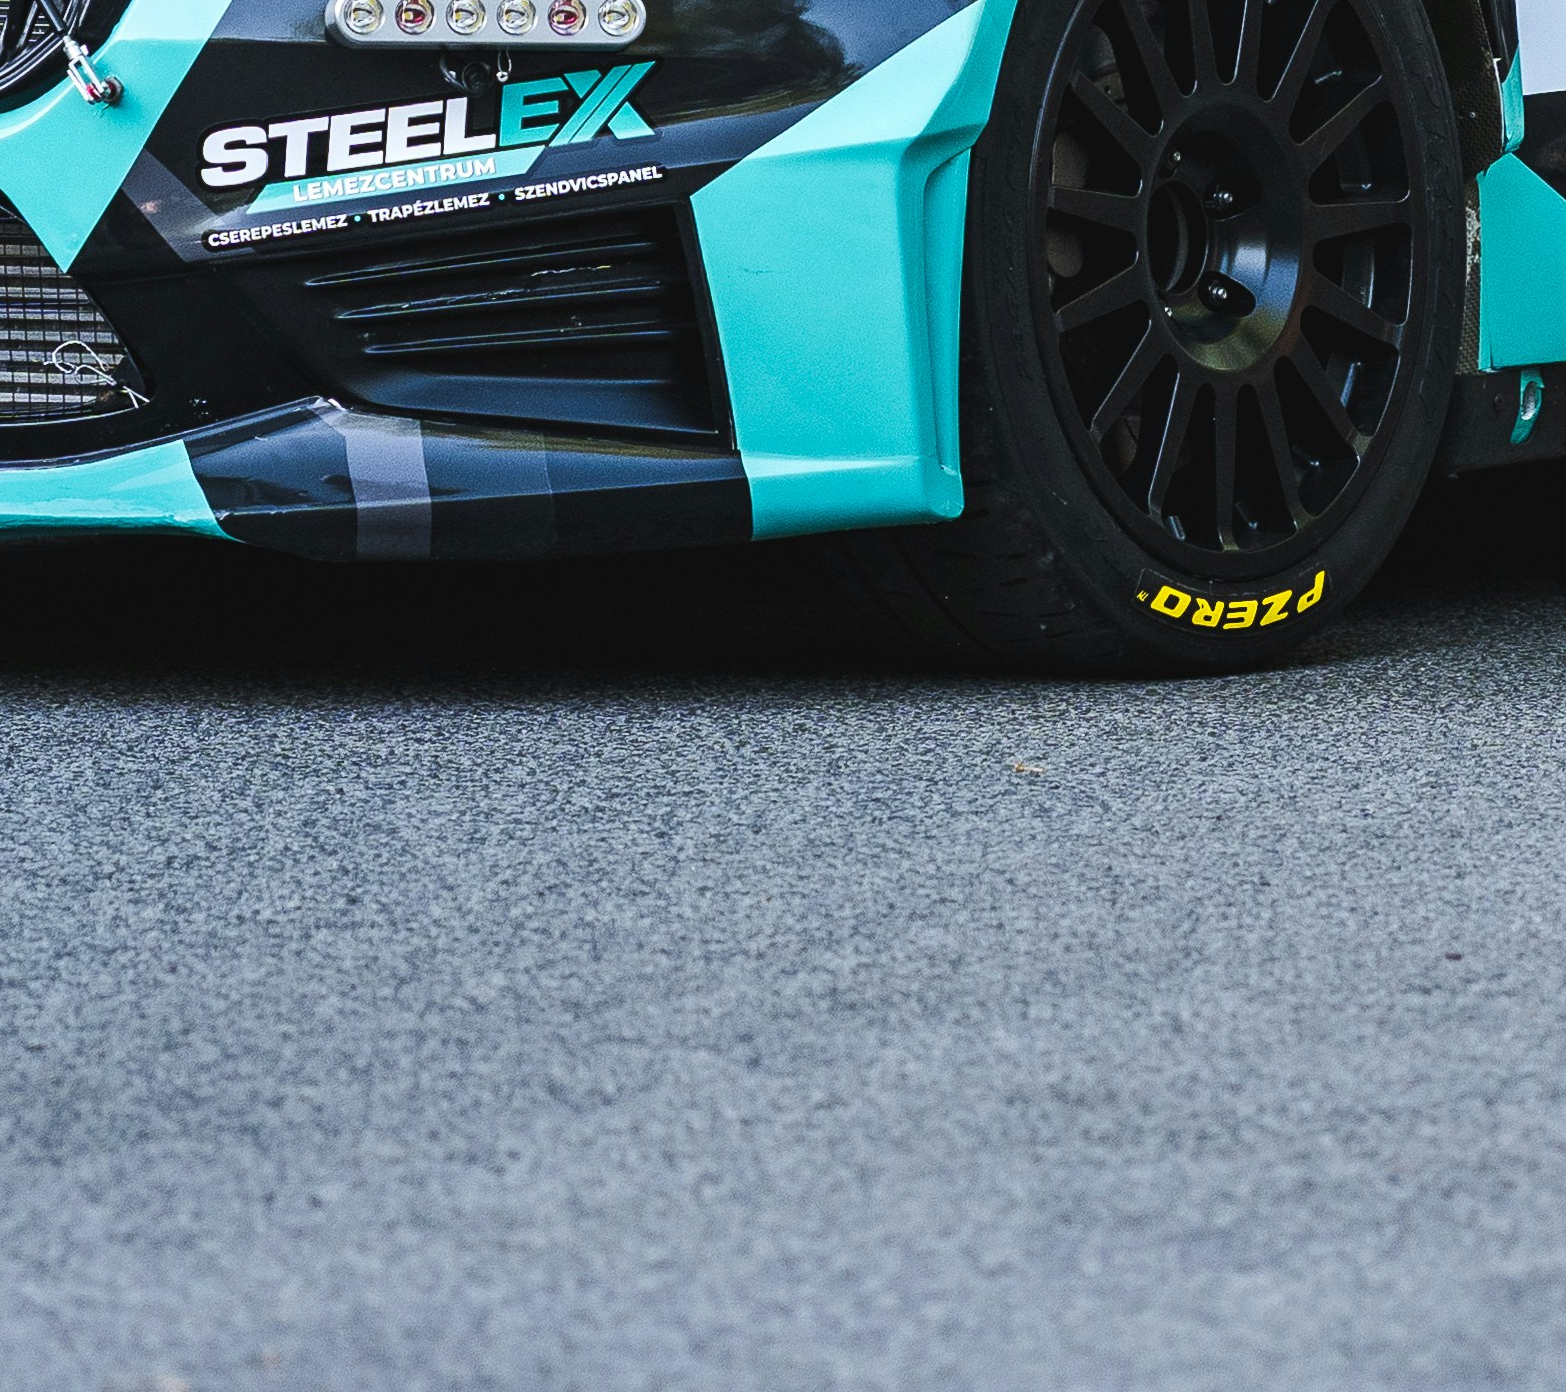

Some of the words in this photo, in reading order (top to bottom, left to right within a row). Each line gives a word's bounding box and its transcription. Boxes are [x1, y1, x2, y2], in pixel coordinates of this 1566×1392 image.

[200, 59, 660, 189] STEELEX
[207, 211, 348, 248] CSEREPESLEMEZ
[366, 191, 492, 226] TRAPÉZLEMEZ
[513, 164, 664, 202] SZENDVICSPANEL
[291, 156, 497, 203] LEMEZCENTRUM
